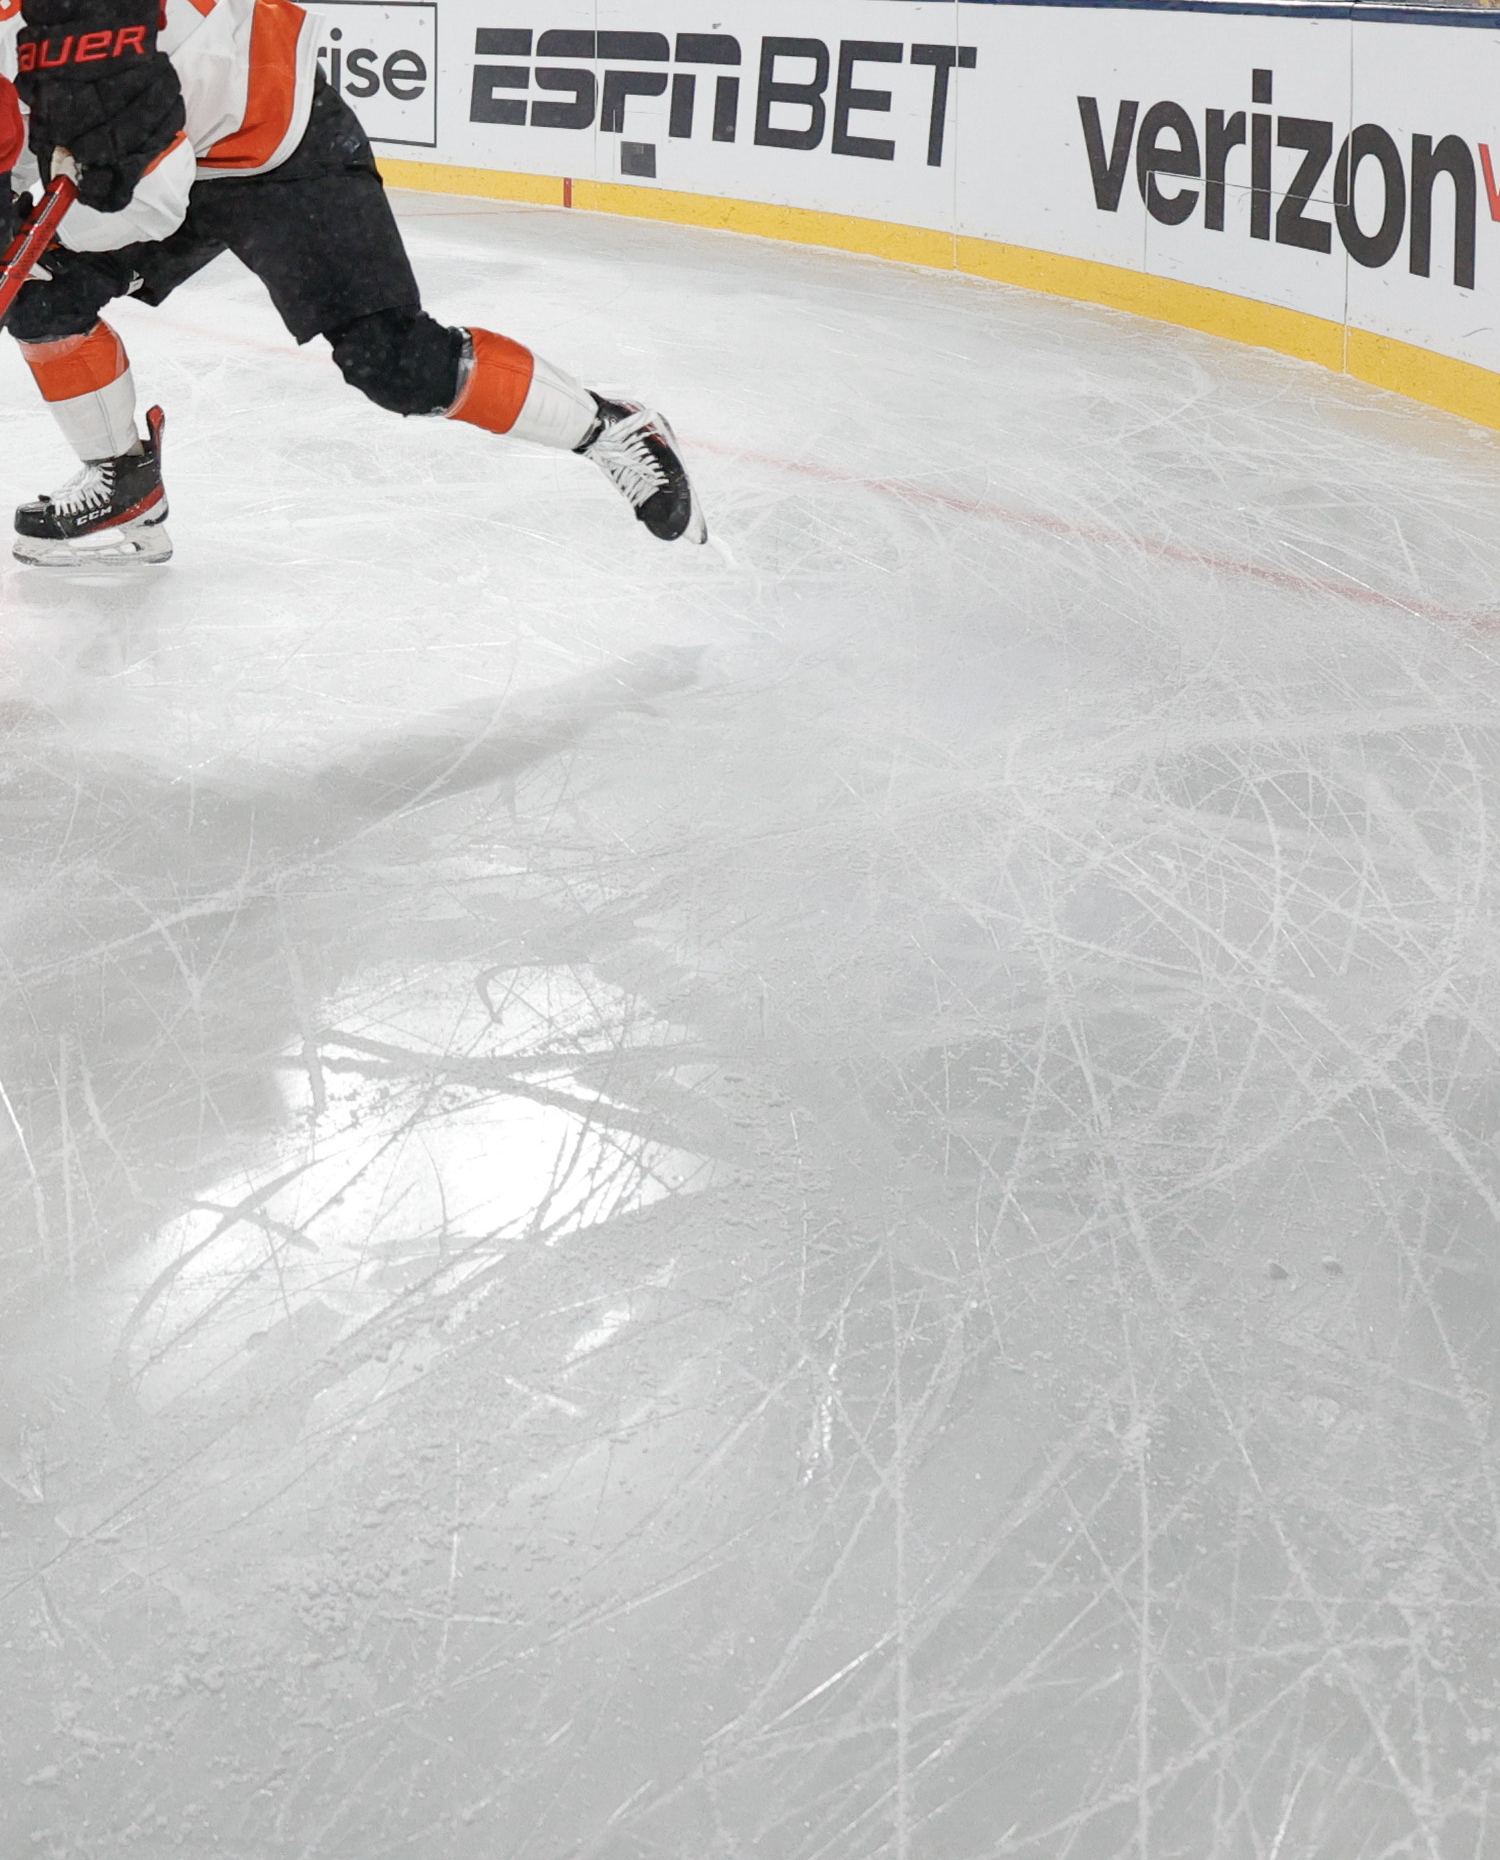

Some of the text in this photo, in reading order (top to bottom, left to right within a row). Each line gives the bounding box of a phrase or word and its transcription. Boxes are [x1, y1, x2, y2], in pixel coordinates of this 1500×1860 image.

[468, 27, 978, 168] ESPN BET
[1076, 67, 1479, 291] verizon
[76, 504, 113, 527] CCM
